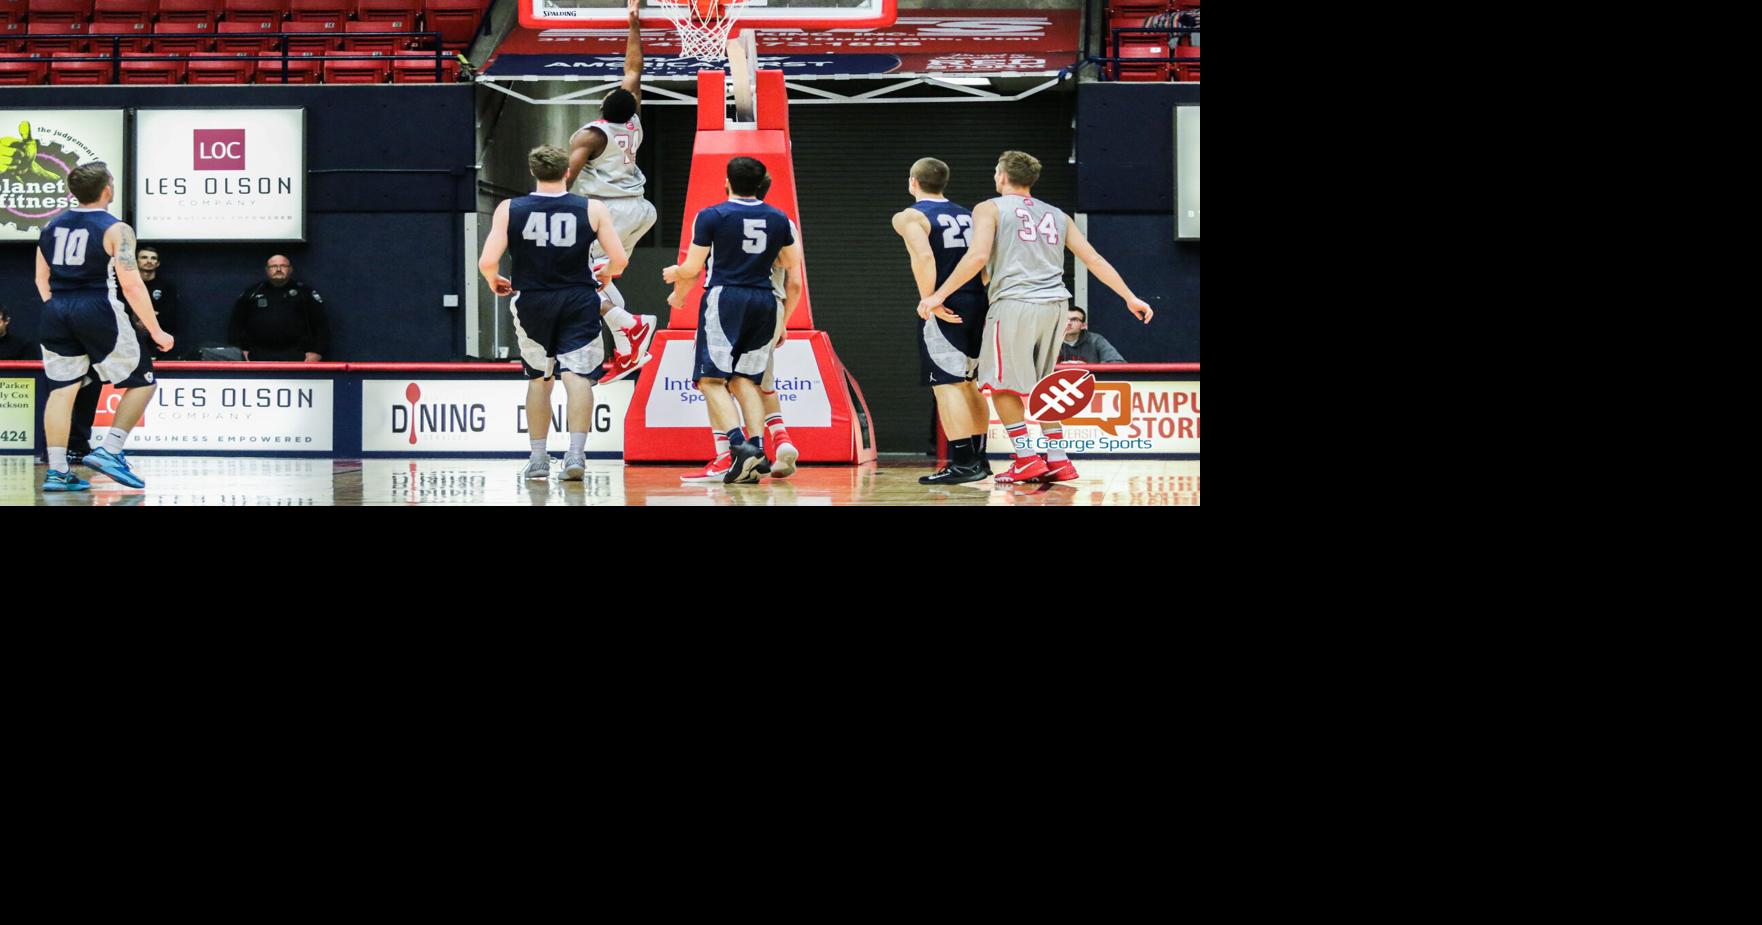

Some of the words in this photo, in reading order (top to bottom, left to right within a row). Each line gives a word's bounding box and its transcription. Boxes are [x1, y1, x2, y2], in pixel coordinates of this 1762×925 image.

[38, 126, 52, 134] the
[53, 130, 95, 157] judgement
[200, 141, 241, 160] LOC
[0, 179, 65, 193] lanet
[145, 177, 187, 195] LES
[205, 177, 291, 195] OLSON
[522, 211, 577, 247] 40
[742, 219, 767, 254] 5
[937, 213, 973, 249] 22
[1015, 207, 1059, 245] 34
[52, 227, 90, 266] 10
[159, 387, 206, 407] LES
[222, 387, 313, 408] OLSON
[158, 412, 252, 420] COMPANY
[0, 430, 27, 442] 424
[134, 435, 208, 443] BUSINESS
[218, 435, 312, 443] EMPOWERED
